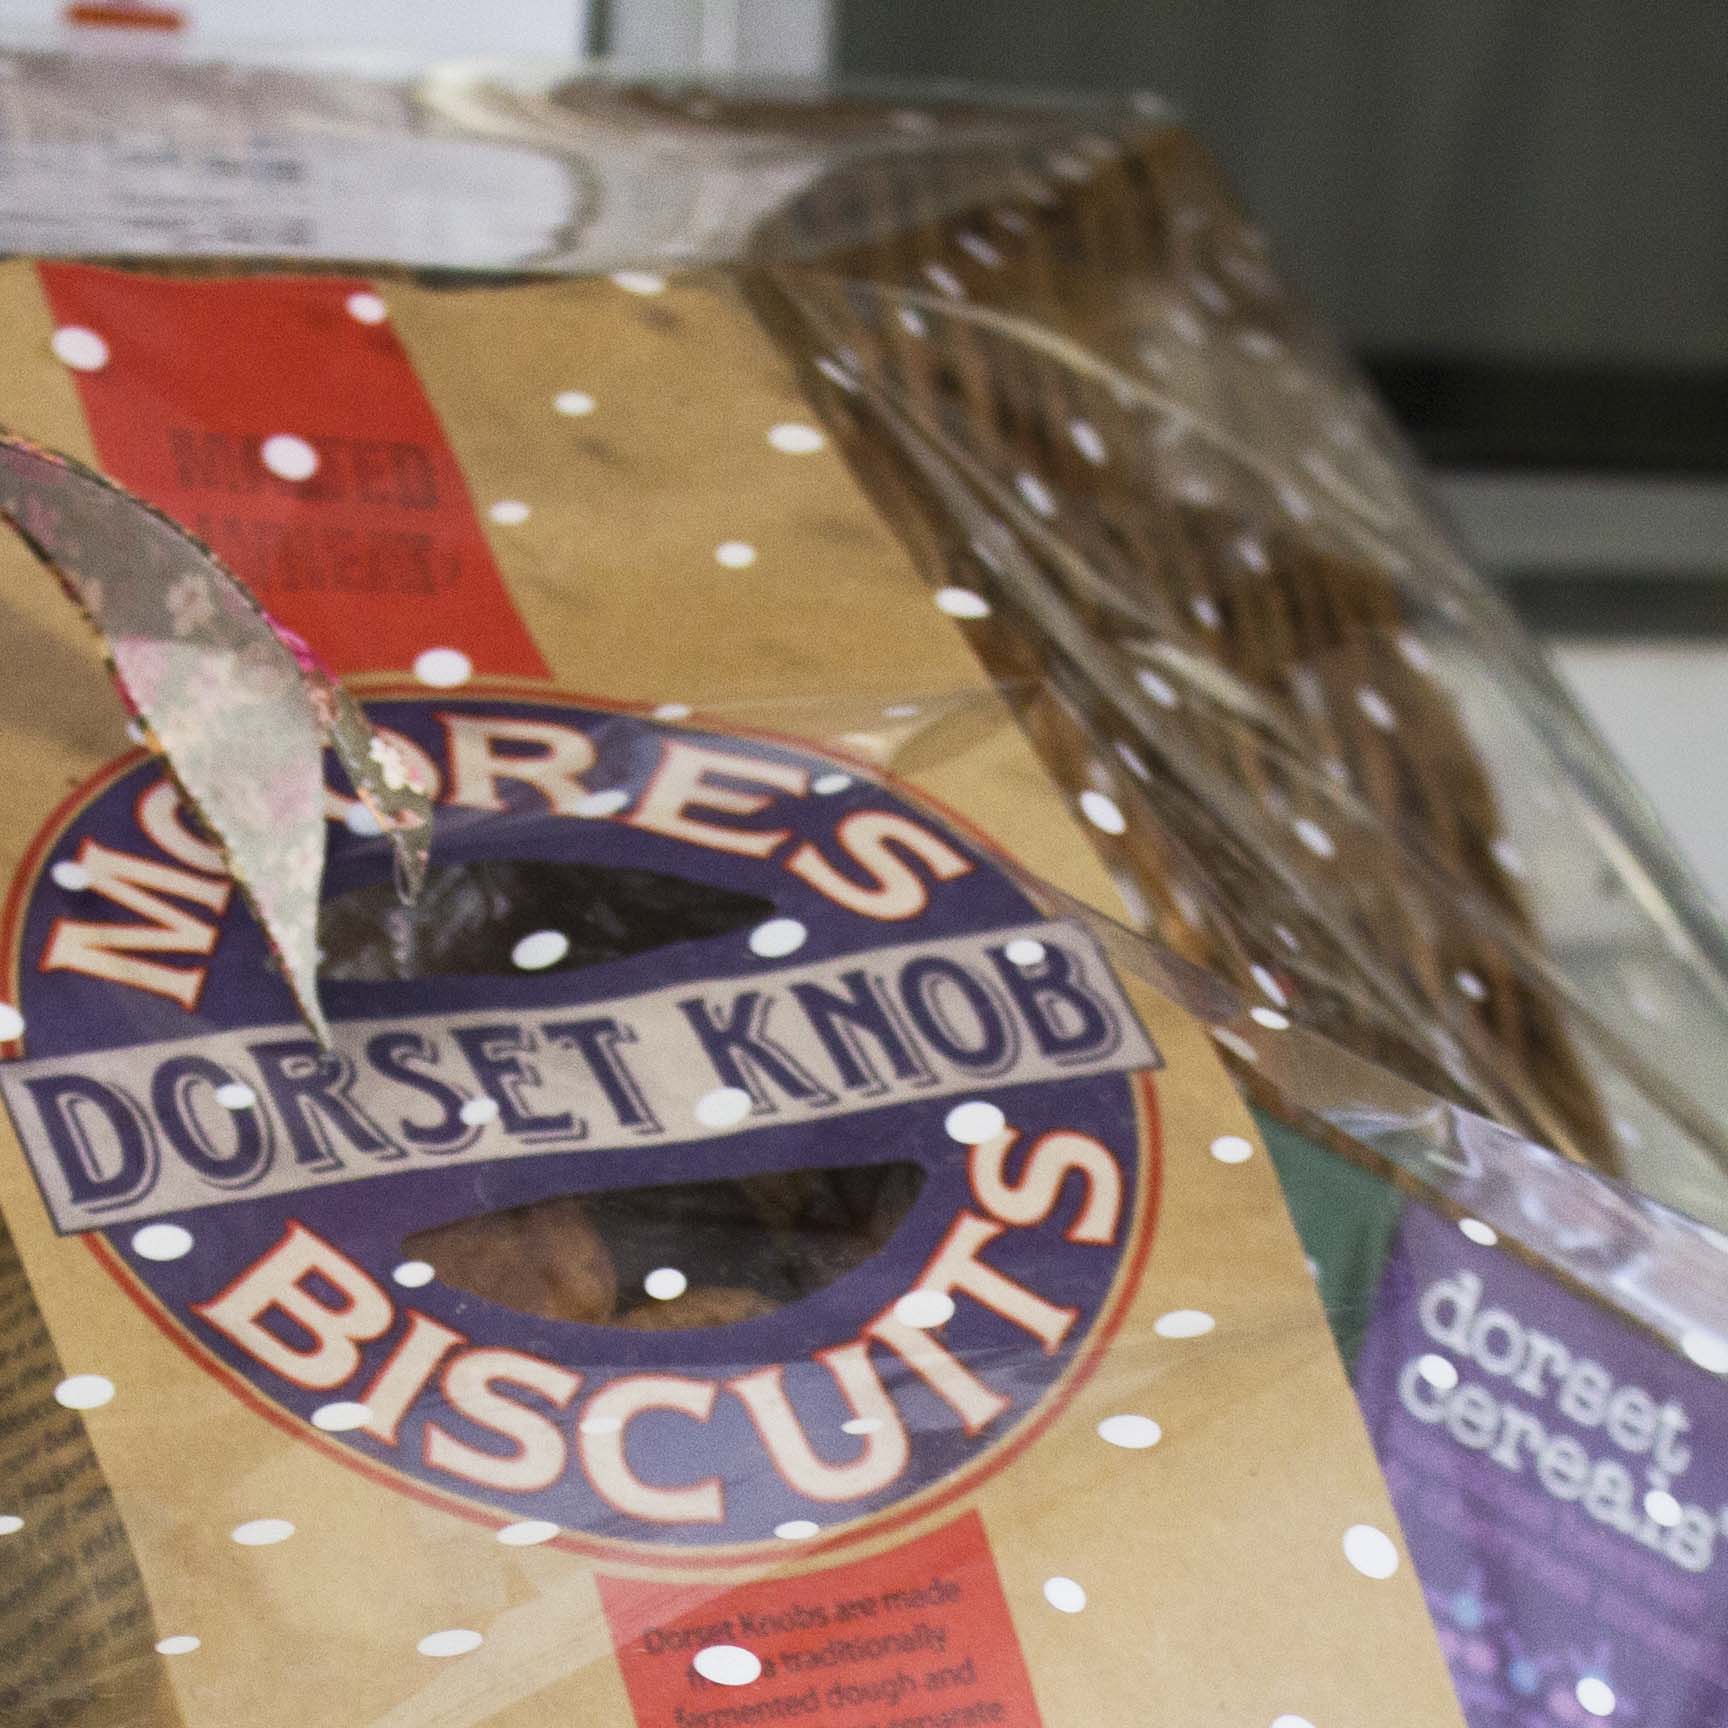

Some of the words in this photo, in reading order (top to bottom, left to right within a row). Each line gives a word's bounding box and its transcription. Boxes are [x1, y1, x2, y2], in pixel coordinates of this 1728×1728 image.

[25, 1016, 652, 1205] DORSET
[681, 939, 1122, 1125] KNOB
[198, 1125, 1123, 1527] BISCUITS
[1418, 1270, 1692, 1477] dorset
[645, 1619, 735, 1655] Dorset
[740, 1604, 829, 1642] Knobs
[835, 1596, 879, 1622] are
[884, 1577, 961, 1611] made
[781, 1621, 947, 1676] traditionally
[827, 1673, 917, 1716] dough
[925, 1657, 975, 1693] and
